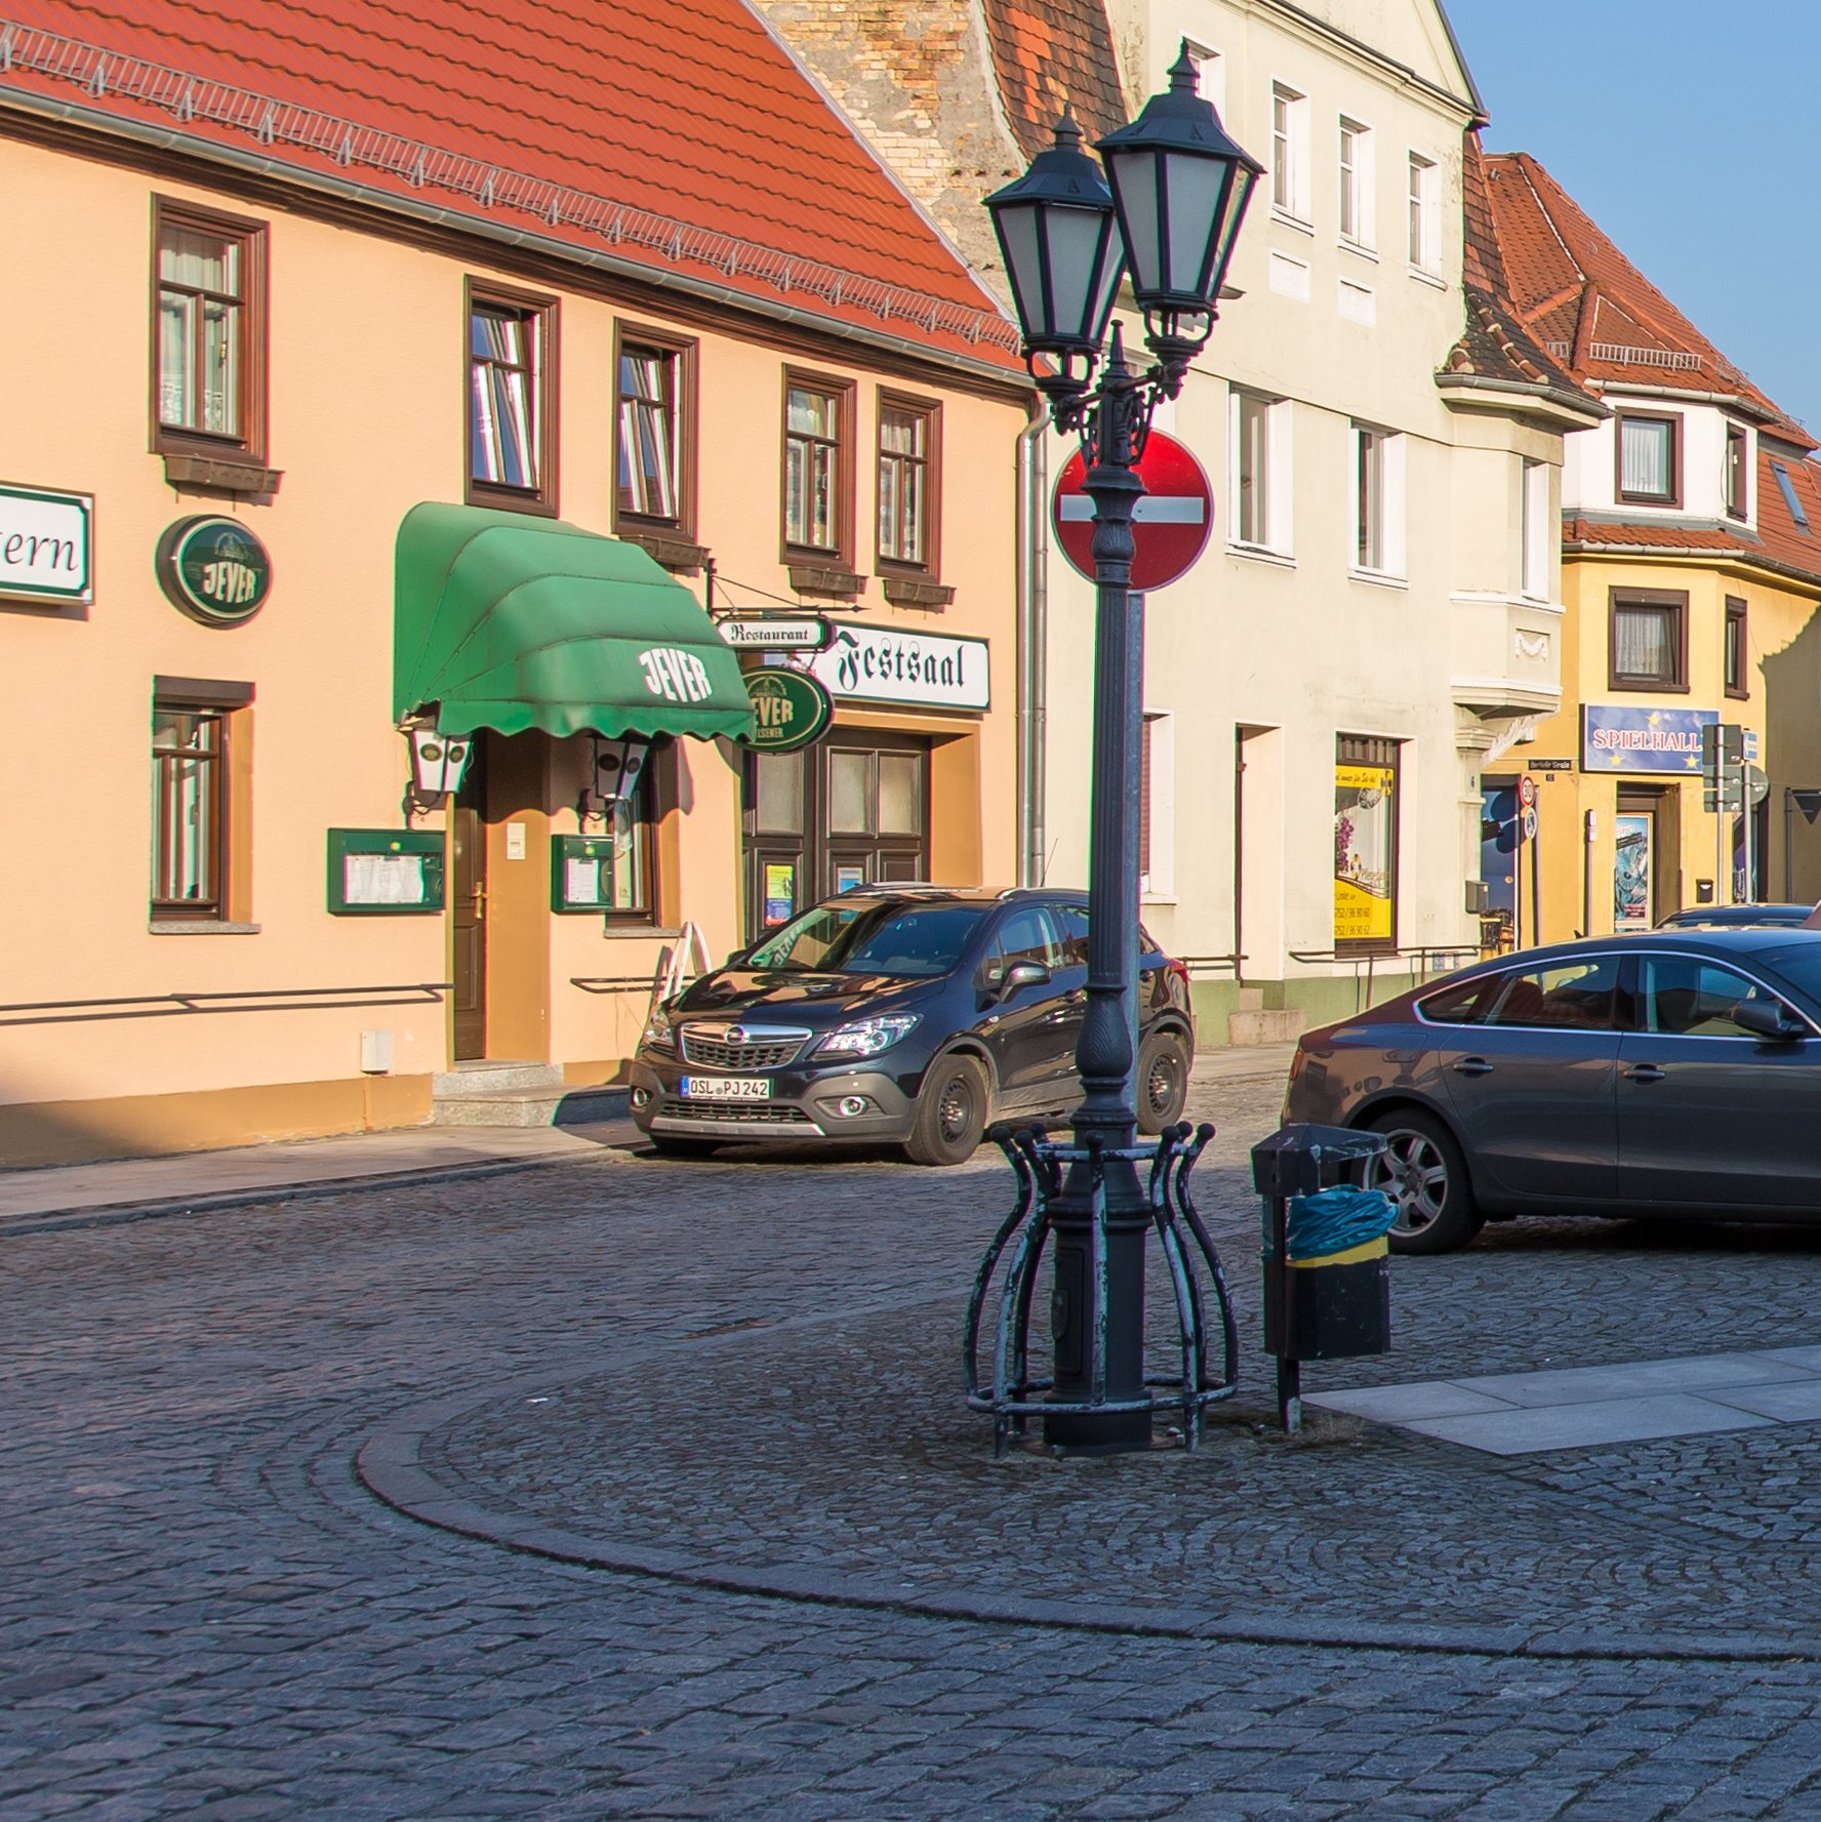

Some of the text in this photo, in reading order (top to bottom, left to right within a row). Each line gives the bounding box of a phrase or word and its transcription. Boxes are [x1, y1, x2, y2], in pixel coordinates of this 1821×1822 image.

[0, 532, 79, 572] ern
[203, 561, 257, 604] JEVER
[731, 624, 809, 642] Restaurant
[639, 648, 713, 703] JEVER
[837, 630, 965, 692] Festsaal
[750, 697, 794, 727] EVER
[1593, 729, 1703, 753] SPIELHALL
[691, 1080, 768, 1096] OSL PJ 242
